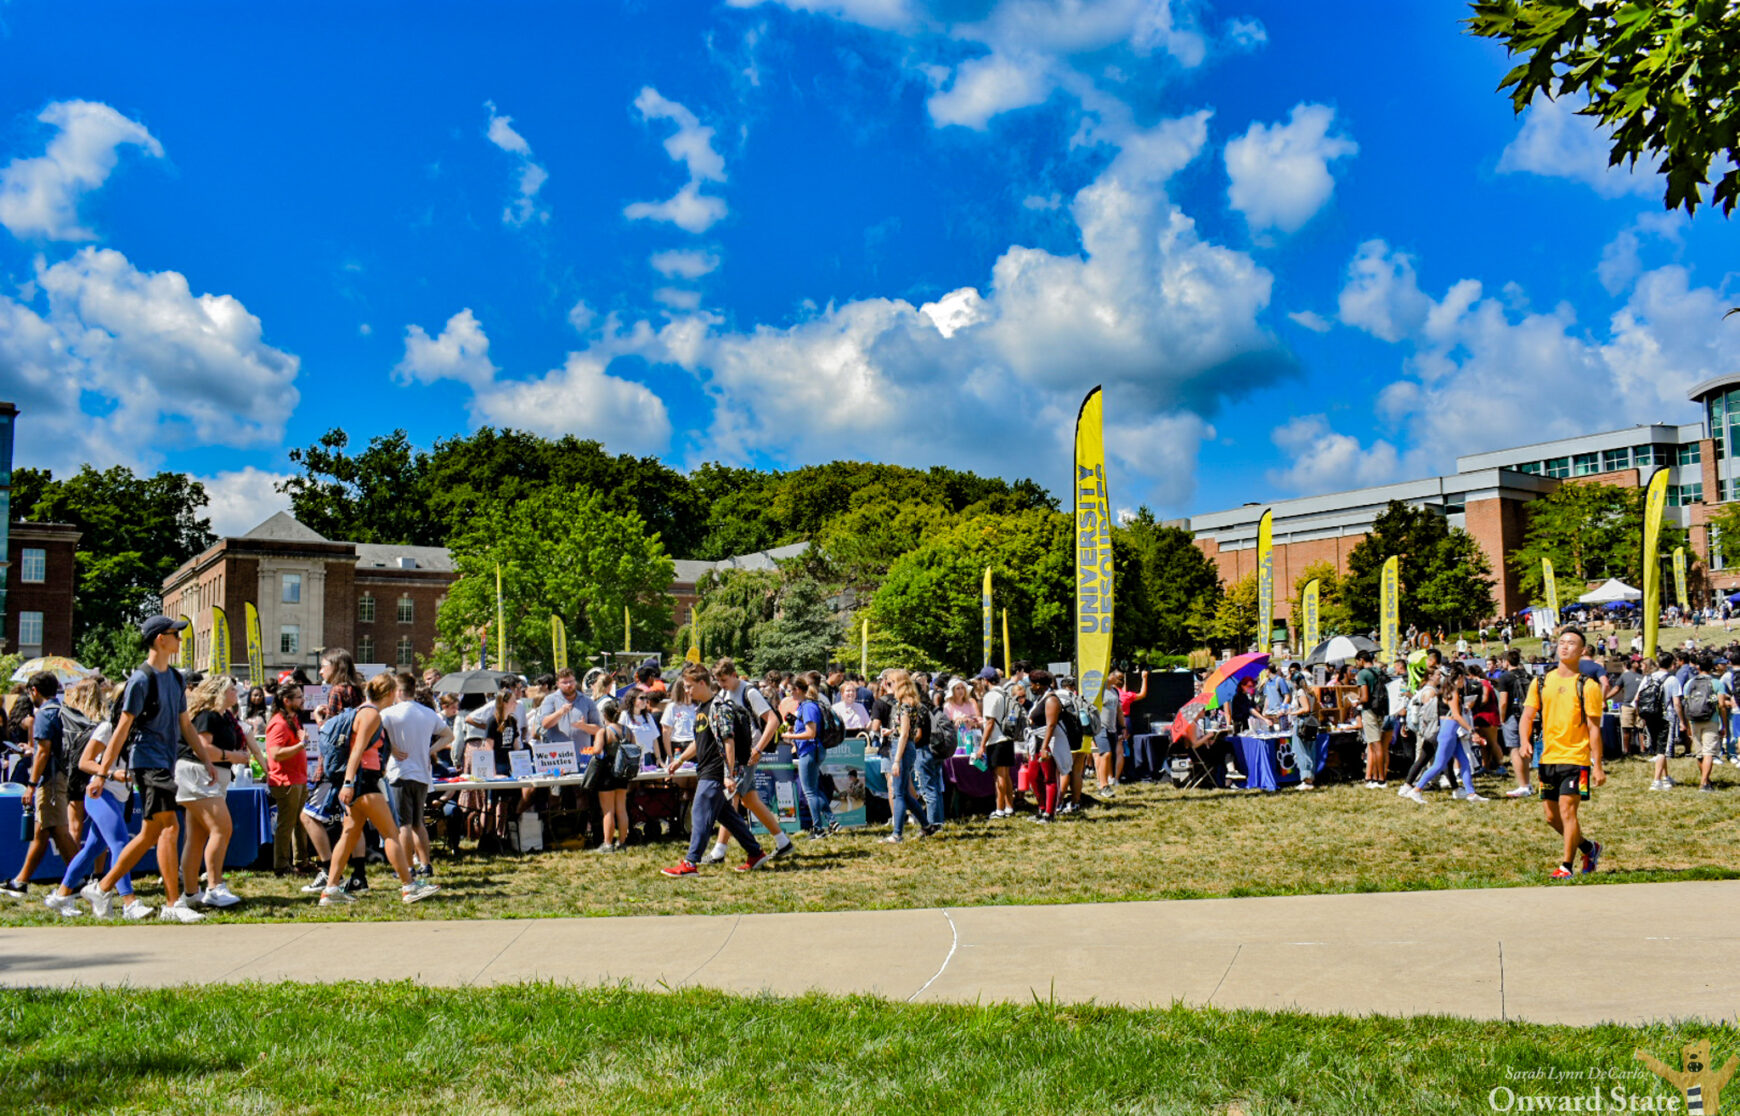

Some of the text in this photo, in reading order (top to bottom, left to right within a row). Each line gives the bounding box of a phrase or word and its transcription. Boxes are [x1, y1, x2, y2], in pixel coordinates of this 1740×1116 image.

[1078, 464, 1099, 633] UNIVERSITY
[1307, 593, 1316, 641] SPORTS
[1386, 569, 1395, 619] SOCIETY
[536, 750, 574, 760] We side
[541, 758, 572, 767] hustles
